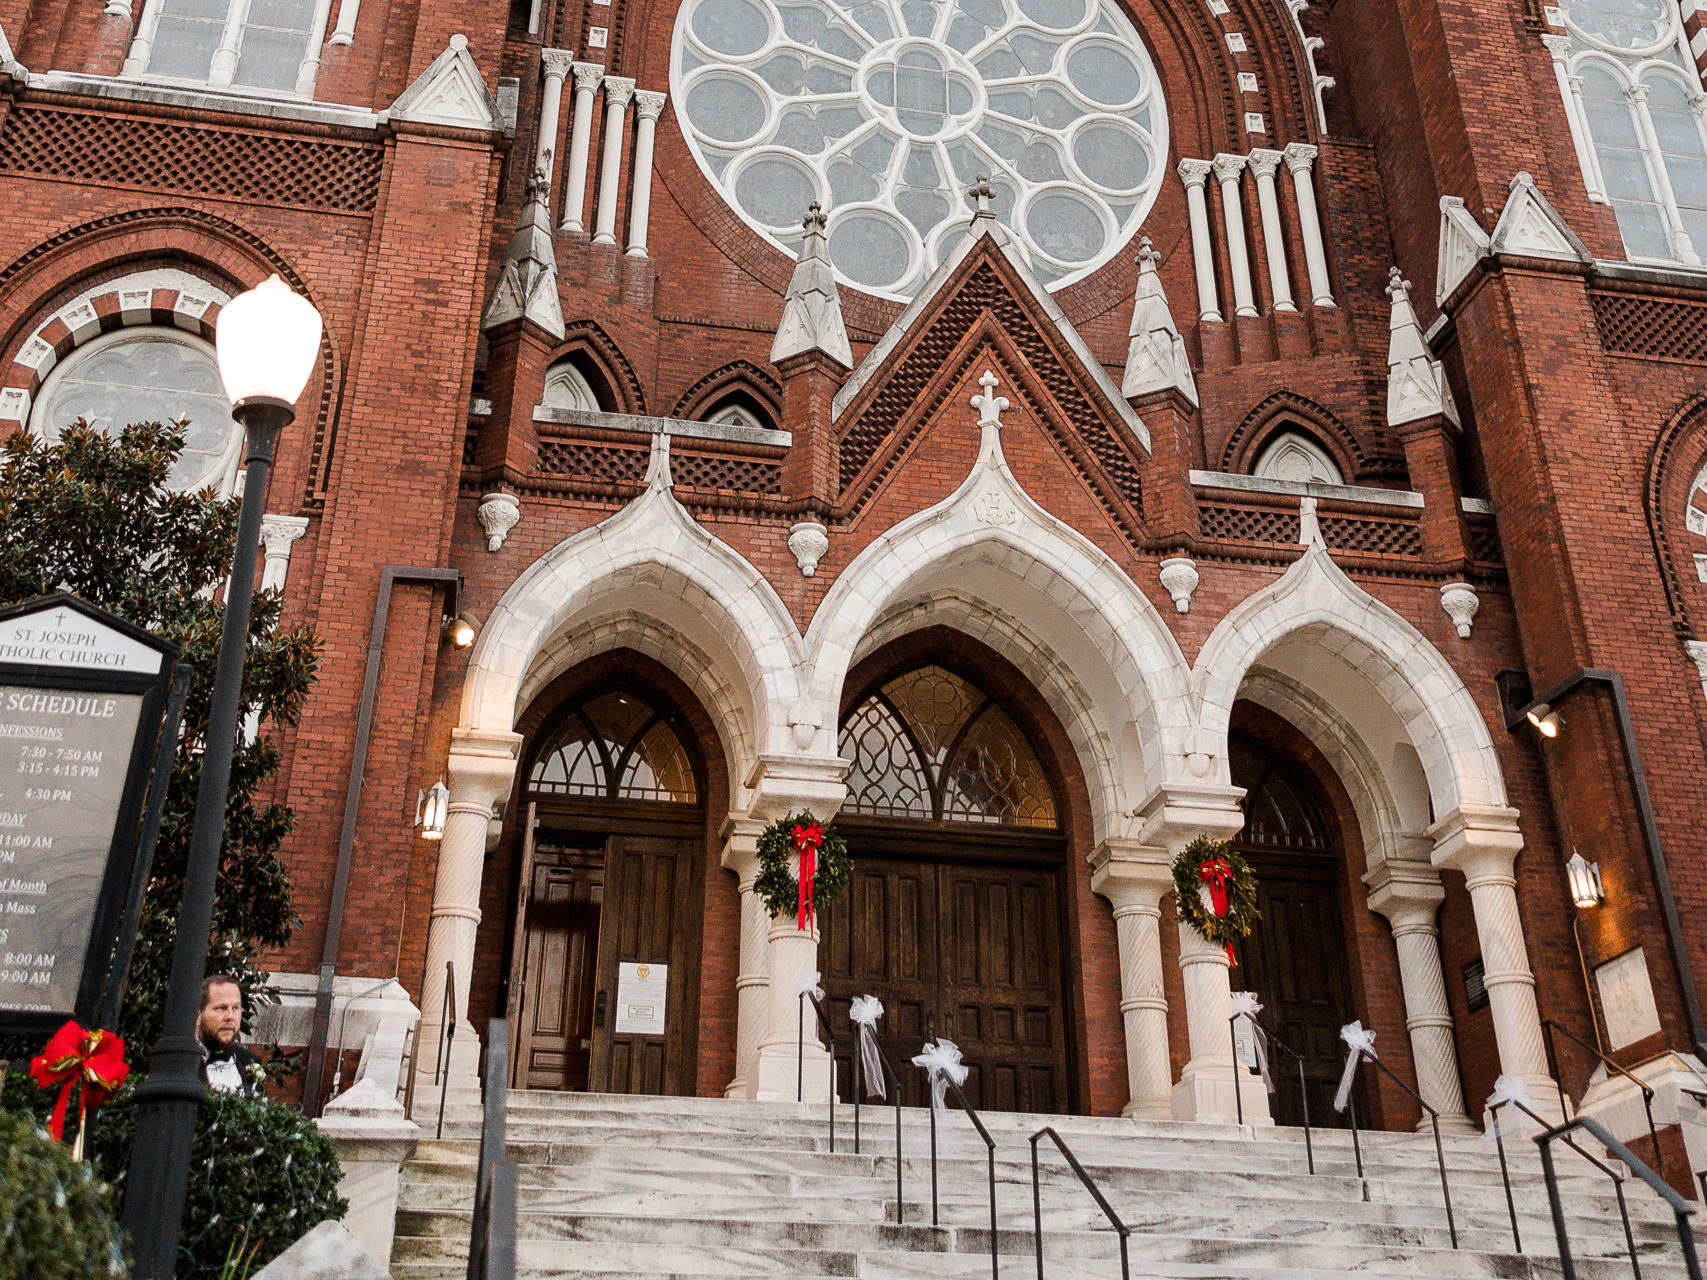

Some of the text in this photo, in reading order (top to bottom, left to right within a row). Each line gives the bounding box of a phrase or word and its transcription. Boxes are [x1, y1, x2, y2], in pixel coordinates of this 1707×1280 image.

[14, 628, 97, 646] ST. JOSEPH
[59, 649, 127, 666] CHURCH
[6, 693, 117, 718] SCHEDULE
[21, 745, 47, 758] 7:30
[56, 748, 82, 761] 7:50
[83, 750, 103, 763] AM
[18, 761, 44, 774] 3:15
[53, 764, 79, 776] 4:15
[80, 765, 100, 778] PM
[25, 787, 72, 802] 4:30 PM
[32, 836, 53, 849] AM
[10, 879, 48, 892] Month
[5, 900, 37, 915] Mass
[4, 951, 56, 967] 8:00 AM
[0, 969, 52, 985] 9:00 AM
